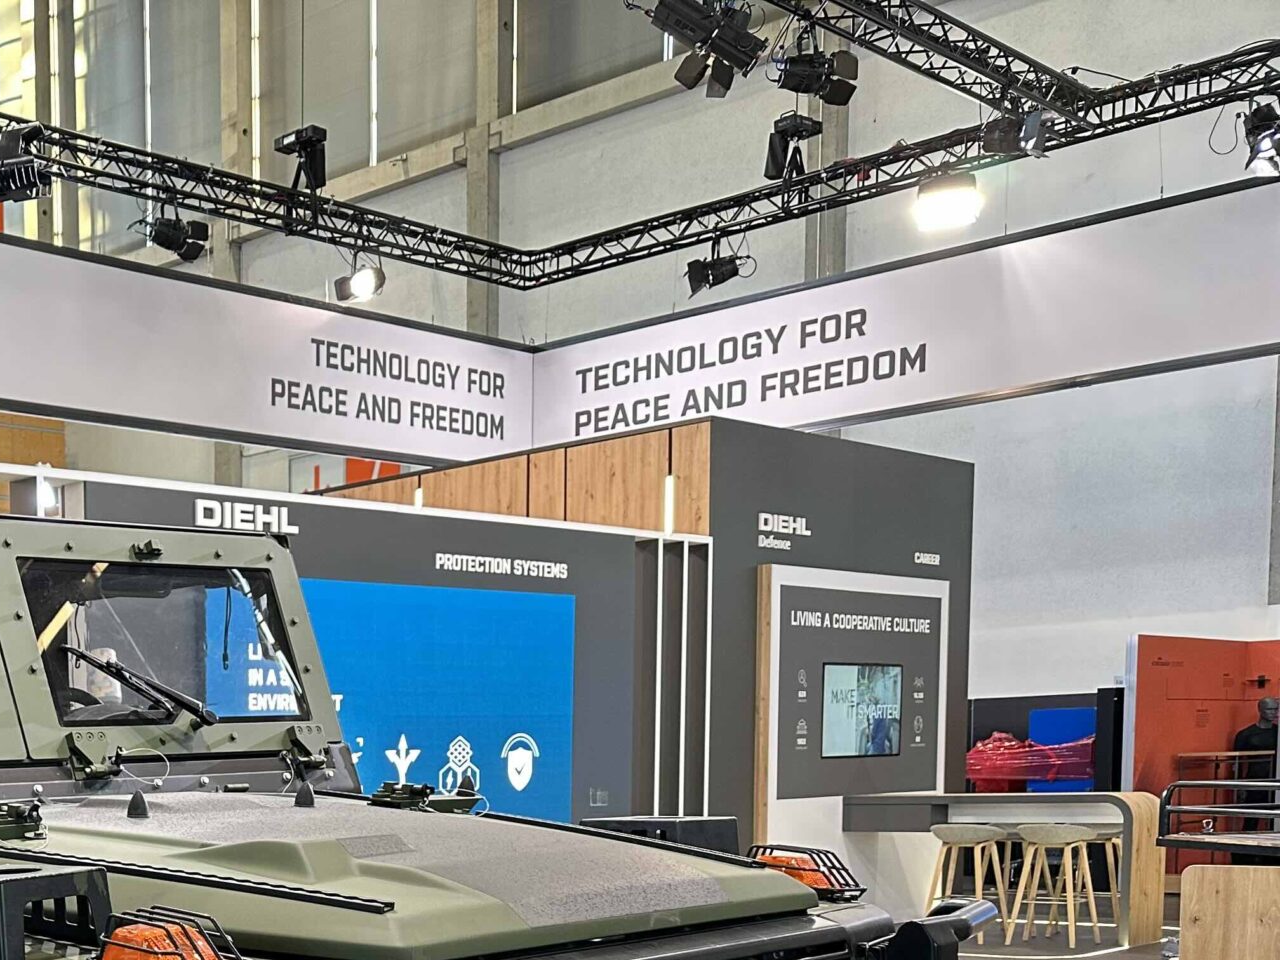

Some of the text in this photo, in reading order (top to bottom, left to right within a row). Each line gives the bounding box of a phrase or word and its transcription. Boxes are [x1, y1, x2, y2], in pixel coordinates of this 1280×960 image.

[576, 308, 867, 395] TECHNOLOGY FOR
[310, 338, 505, 399] TECHNOLOGY FOR
[574, 343, 927, 437] PEACE AND FREEDOM
[270, 378, 505, 441] PEACE AND FREEDOM
[194, 498, 300, 535] DIEHL
[758, 512, 812, 536] DIEHL
[758, 534, 792, 550] Defence
[435, 553, 569, 579] PROTECTION SYSTEMS
[914, 551, 940, 566] CAREER
[791, 610, 930, 634] LIVING A COOPERATIVE CULTURE
[248, 668, 264, 687] IN
[266, 668, 277, 686] A
[831, 689, 856, 704] MAKE
